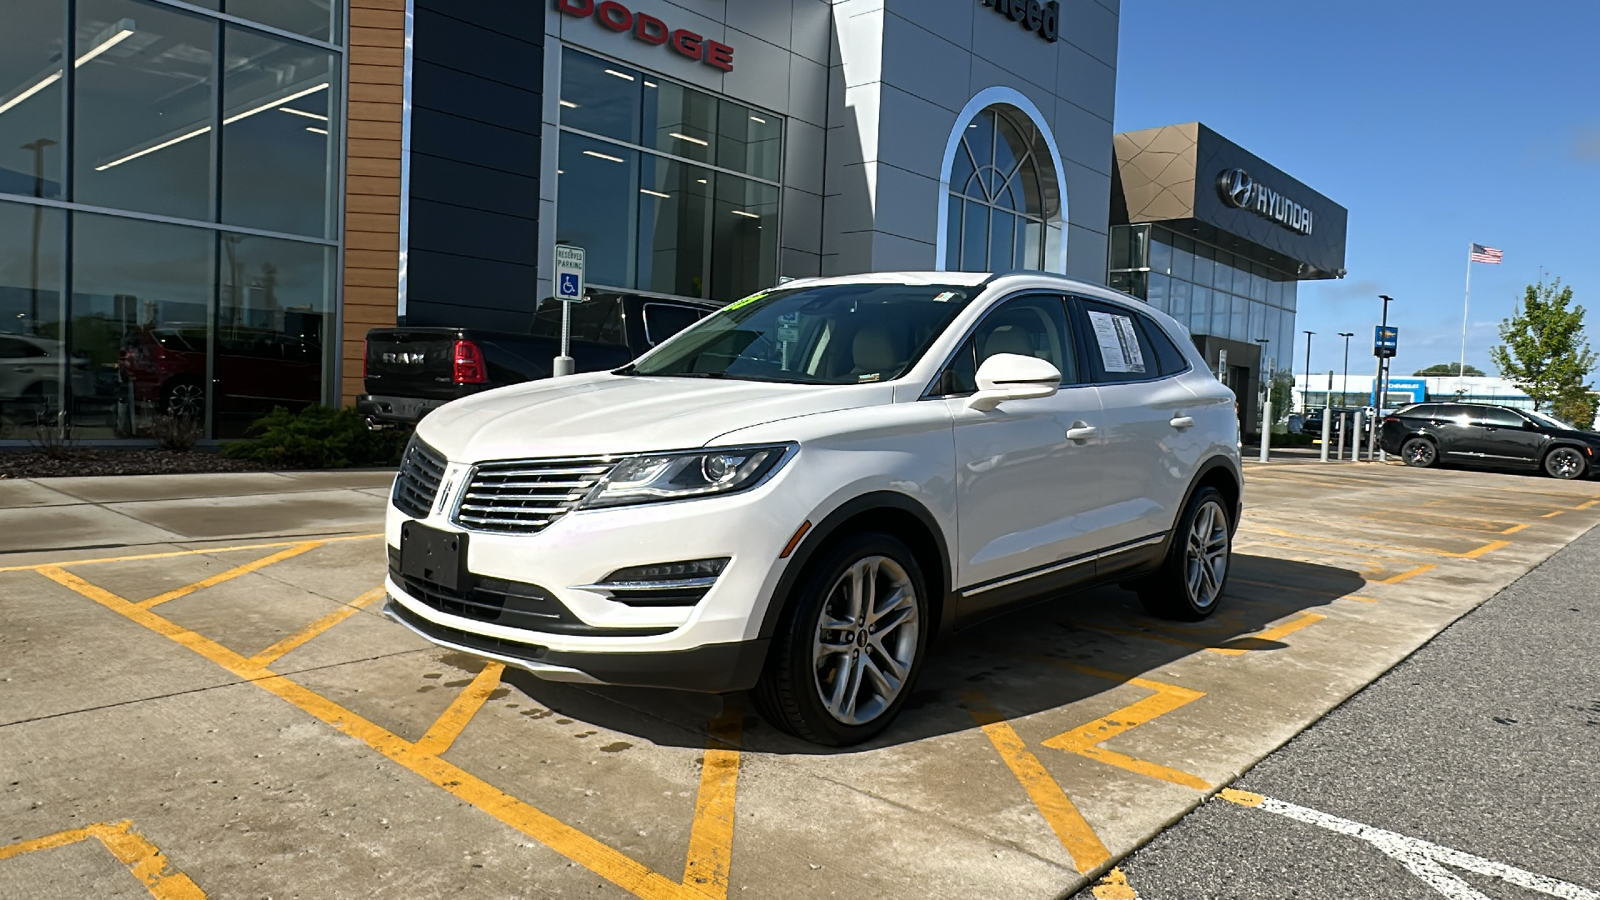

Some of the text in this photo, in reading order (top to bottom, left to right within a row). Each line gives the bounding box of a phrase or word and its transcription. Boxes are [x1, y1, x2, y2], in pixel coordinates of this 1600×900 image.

[981, 0, 1059, 42] eed
[1256, 183, 1313, 235] HYUNDAI
[558, 250, 582, 260] RESERVED
[557, 260, 582, 270] PARKING
[382, 352, 425, 364] RAM
